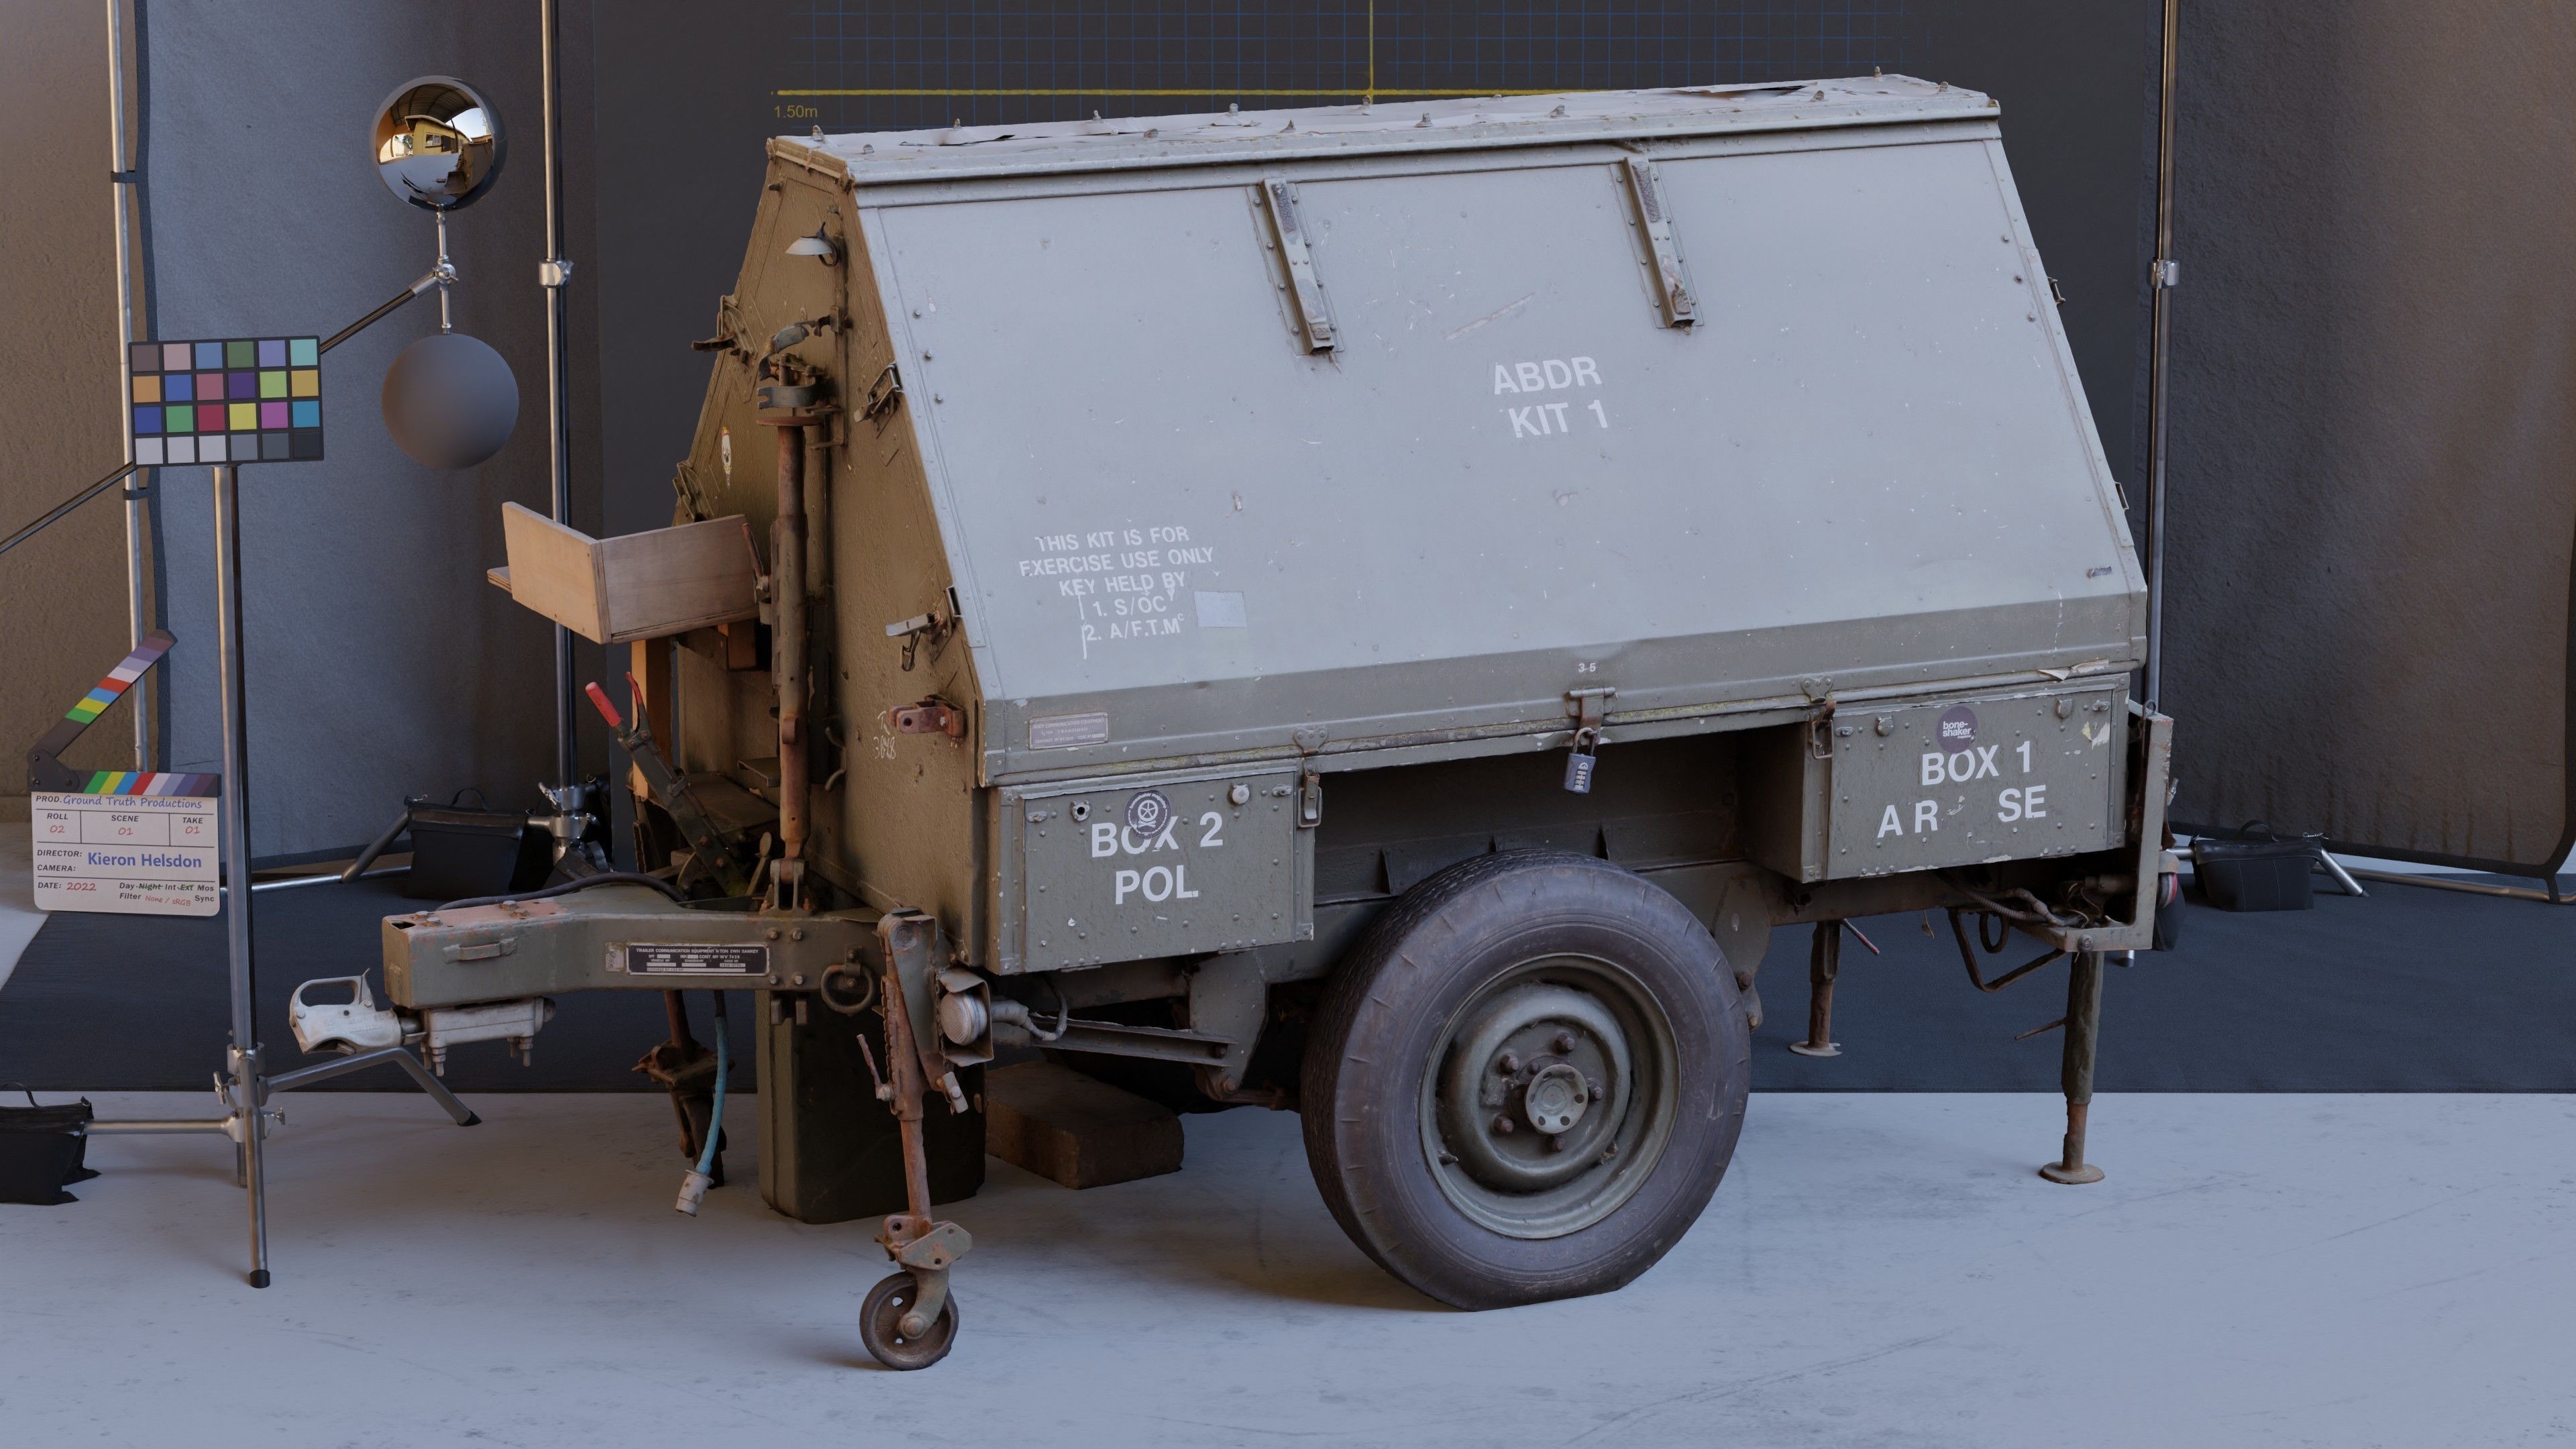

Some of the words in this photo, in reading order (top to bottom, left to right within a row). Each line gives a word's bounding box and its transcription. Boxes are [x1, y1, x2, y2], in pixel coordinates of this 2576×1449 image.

[773, 105, 818, 118] 1.50m
[1494, 356, 1603, 394] ABDR
[1508, 402, 1569, 438] KIT
[1587, 399, 1608, 429] 1
[1034, 534, 1079, 552] THIS
[1087, 531, 1115, 548] KIT
[1124, 529, 1143, 546] IS
[1150, 526, 1190, 543] FOR
[1121, 549, 1161, 568] USE
[1168, 547, 1214, 565] ONLY
[1059, 578, 1095, 597] KEY
[1104, 574, 1155, 593] HELD
[1162, 572, 1185, 590] BY
[1092, 601, 1108, 616] 1.
[1114, 595, 1167, 616] S/OC
[1083, 624, 1102, 641] 2.
[1942, 728, 1972, 737] shaker
[1943, 721, 1968, 730] bone-
[1922, 745, 2000, 786] BOX
[2016, 741, 2031, 773] 1
[63, 795, 102, 805] Ground
[106, 796, 136, 806] Truth
[140, 798, 203, 809] Productions
[50, 825, 65, 833] 02
[118, 827, 133, 836] 01
[185, 826, 200, 834] 01
[1091, 815, 1179, 858] BOX
[1199, 812, 1224, 847] 2
[88, 852, 136, 866] Kieron
[141, 853, 202, 868] Helsdon
[66, 882, 97, 892] 2022
[119, 882, 135, 890] Day
[1115, 865, 1199, 905] POL
[145, 895, 163, 903] None
[172, 899, 191, 907] sRGB
[195, 895, 215, 903] Sync
